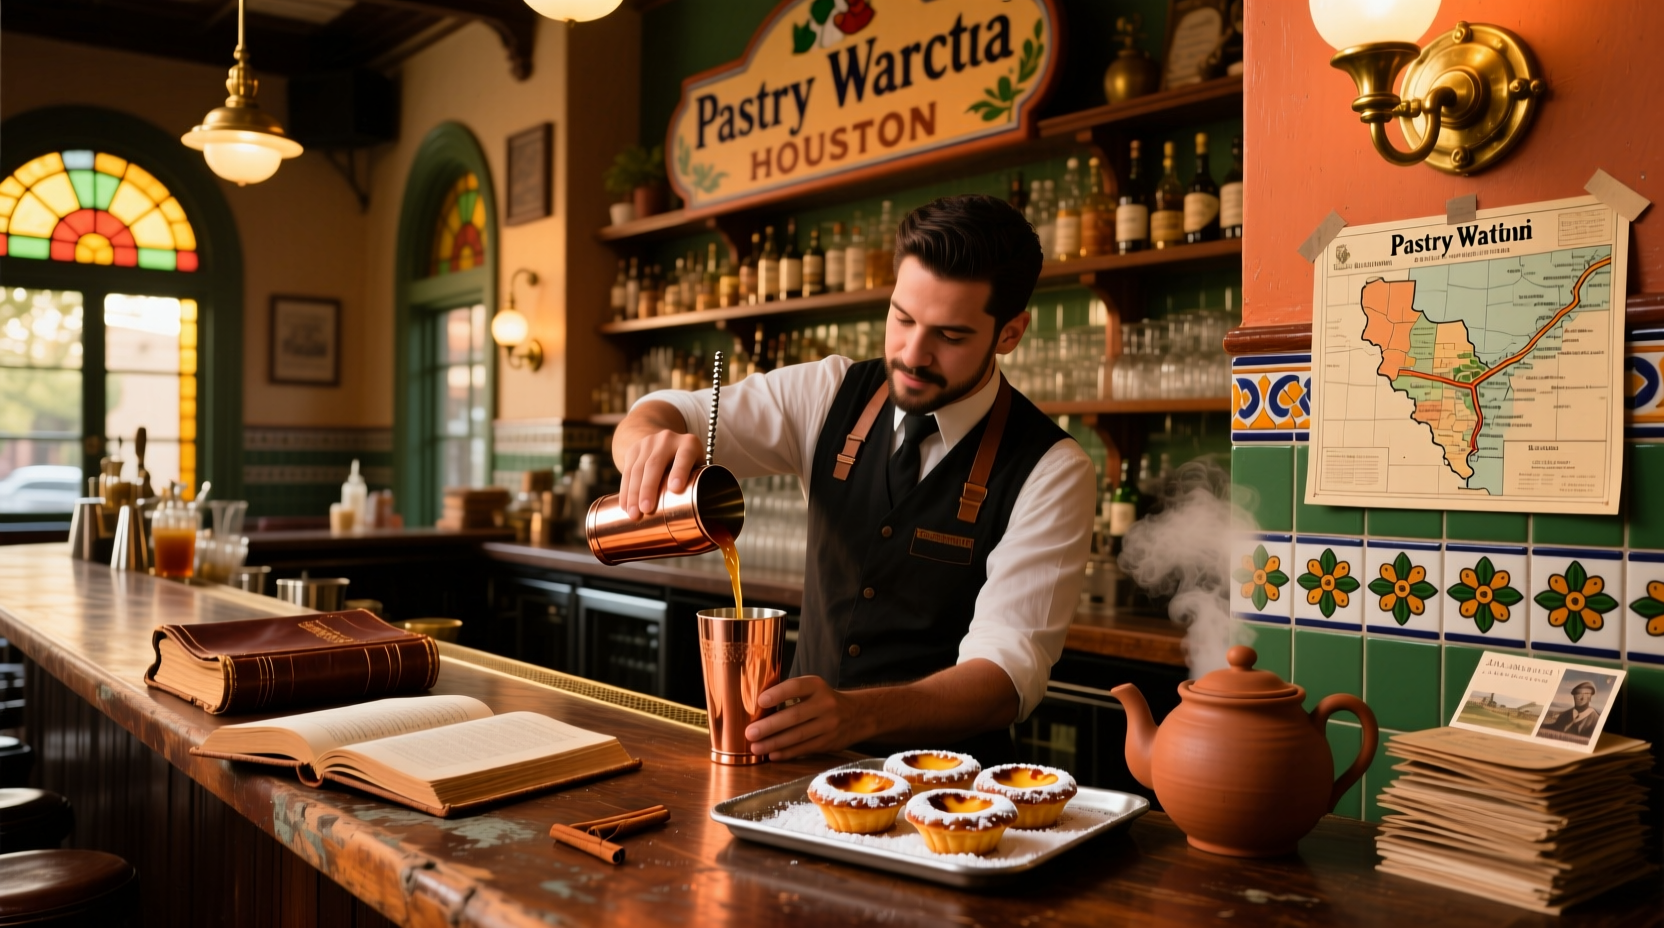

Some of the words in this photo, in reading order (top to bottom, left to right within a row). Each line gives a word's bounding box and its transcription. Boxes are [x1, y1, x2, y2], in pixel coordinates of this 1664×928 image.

[695, 77, 816, 150] Pastry
[749, 100, 938, 182] HOUSTON
[1390, 233, 1454, 258] Pastry
